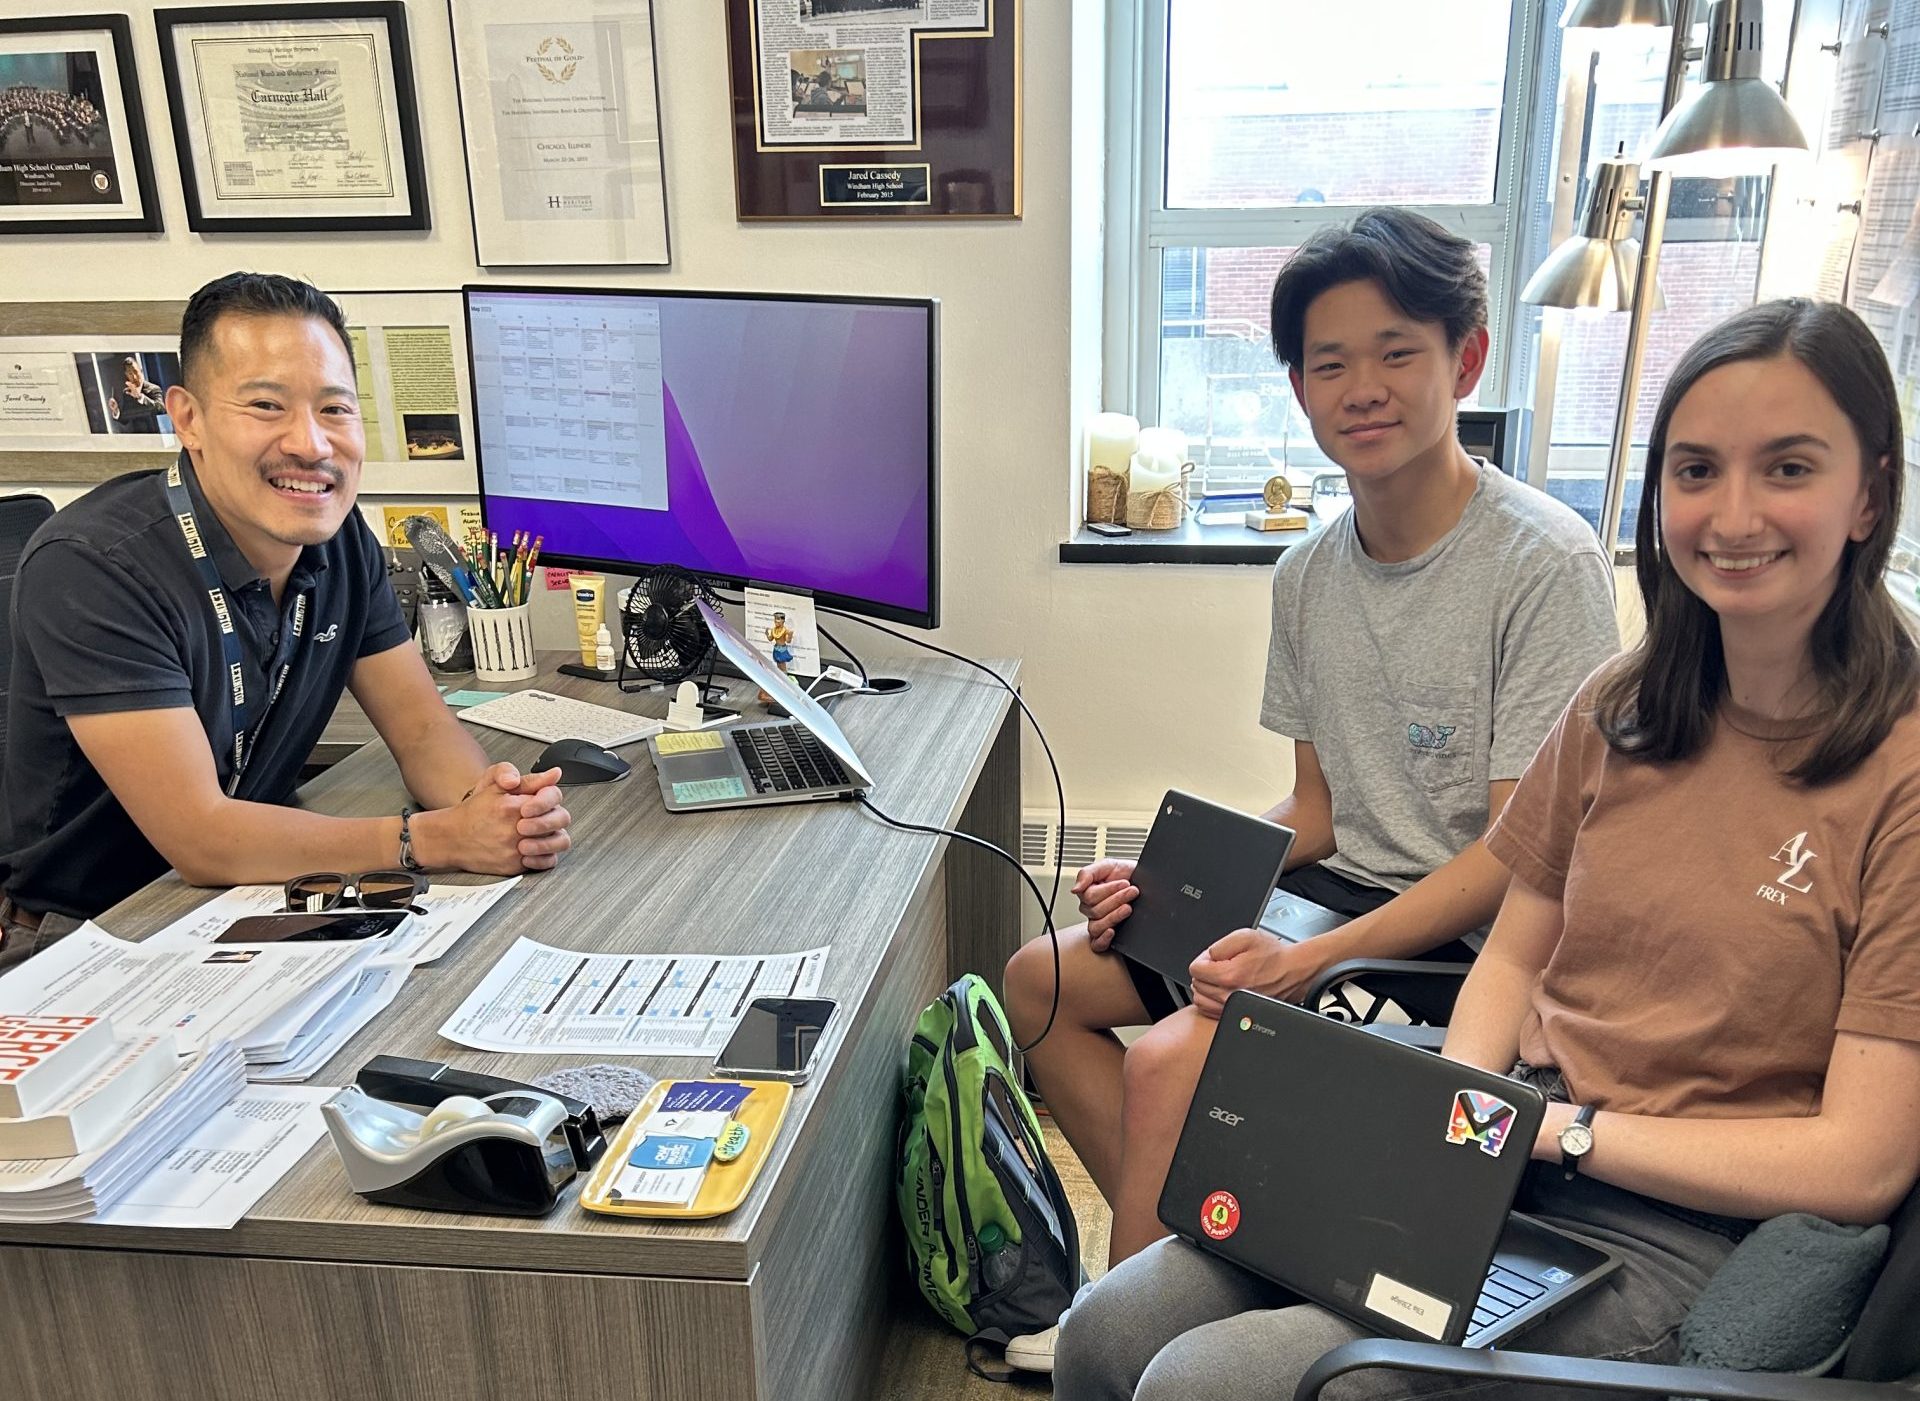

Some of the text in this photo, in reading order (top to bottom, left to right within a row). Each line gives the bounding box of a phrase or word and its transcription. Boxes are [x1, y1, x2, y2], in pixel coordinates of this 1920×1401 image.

[250, 88, 329, 106] Carnegie Hall
[13, 164, 28, 173] High
[29, 163, 49, 171] School
[848, 171, 901, 181] Jared Cassedy
[857, 191, 880, 199] February
[178, 512, 207, 560] LEXINGTON
[209, 587, 234, 635] LEXINGTON
[293, 594, 307, 637] LEXINGTON
[230, 662, 245, 706] LEXINGTON
[1180, 884, 1203, 900] ASUS
[1756, 884, 1789, 906] FREX
[1251, 1022, 1277, 1037] chrome
[1208, 1106, 1245, 1127] acer
[916, 1166, 931, 1237] UNDER
